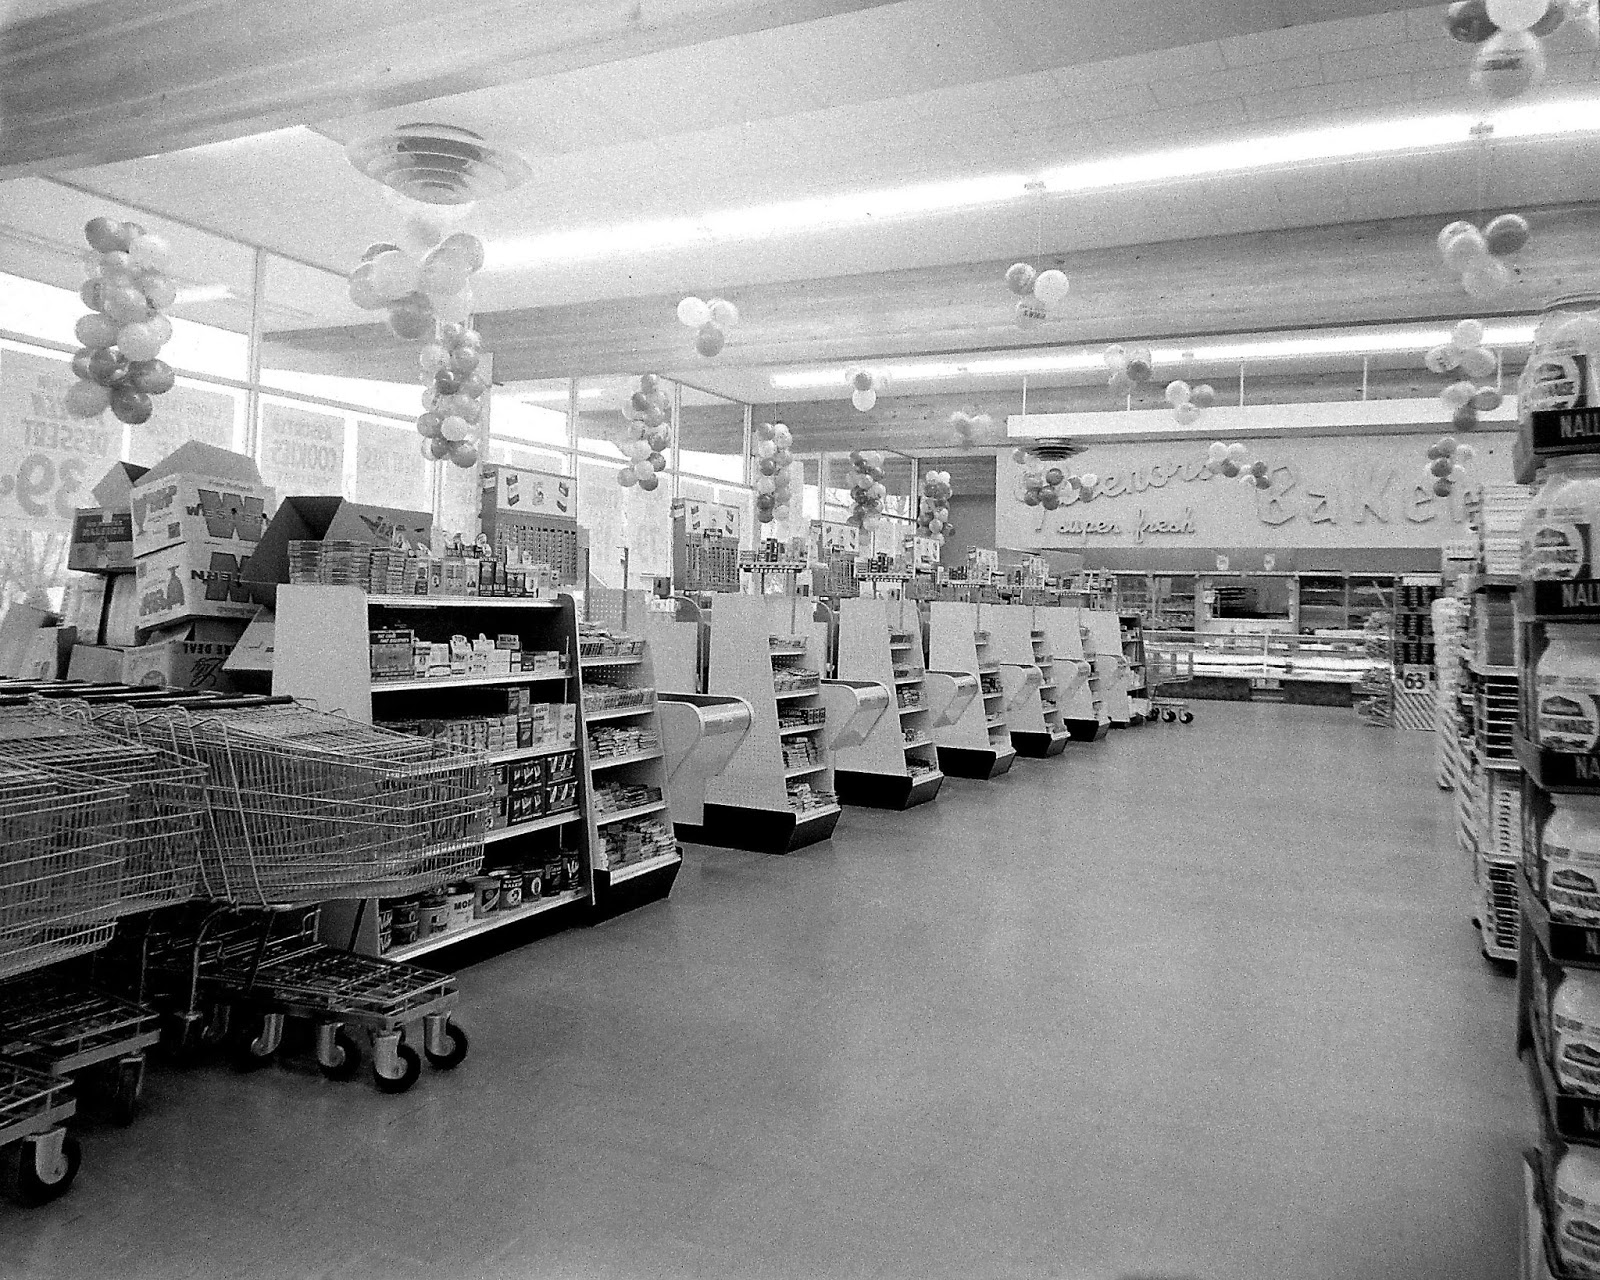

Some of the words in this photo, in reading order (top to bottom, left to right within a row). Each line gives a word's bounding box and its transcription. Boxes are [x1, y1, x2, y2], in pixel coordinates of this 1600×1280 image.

[1057, 519, 1122, 545] super
[1130, 506, 1196, 545] fresh
[183, 643, 212, 654] DEAL
